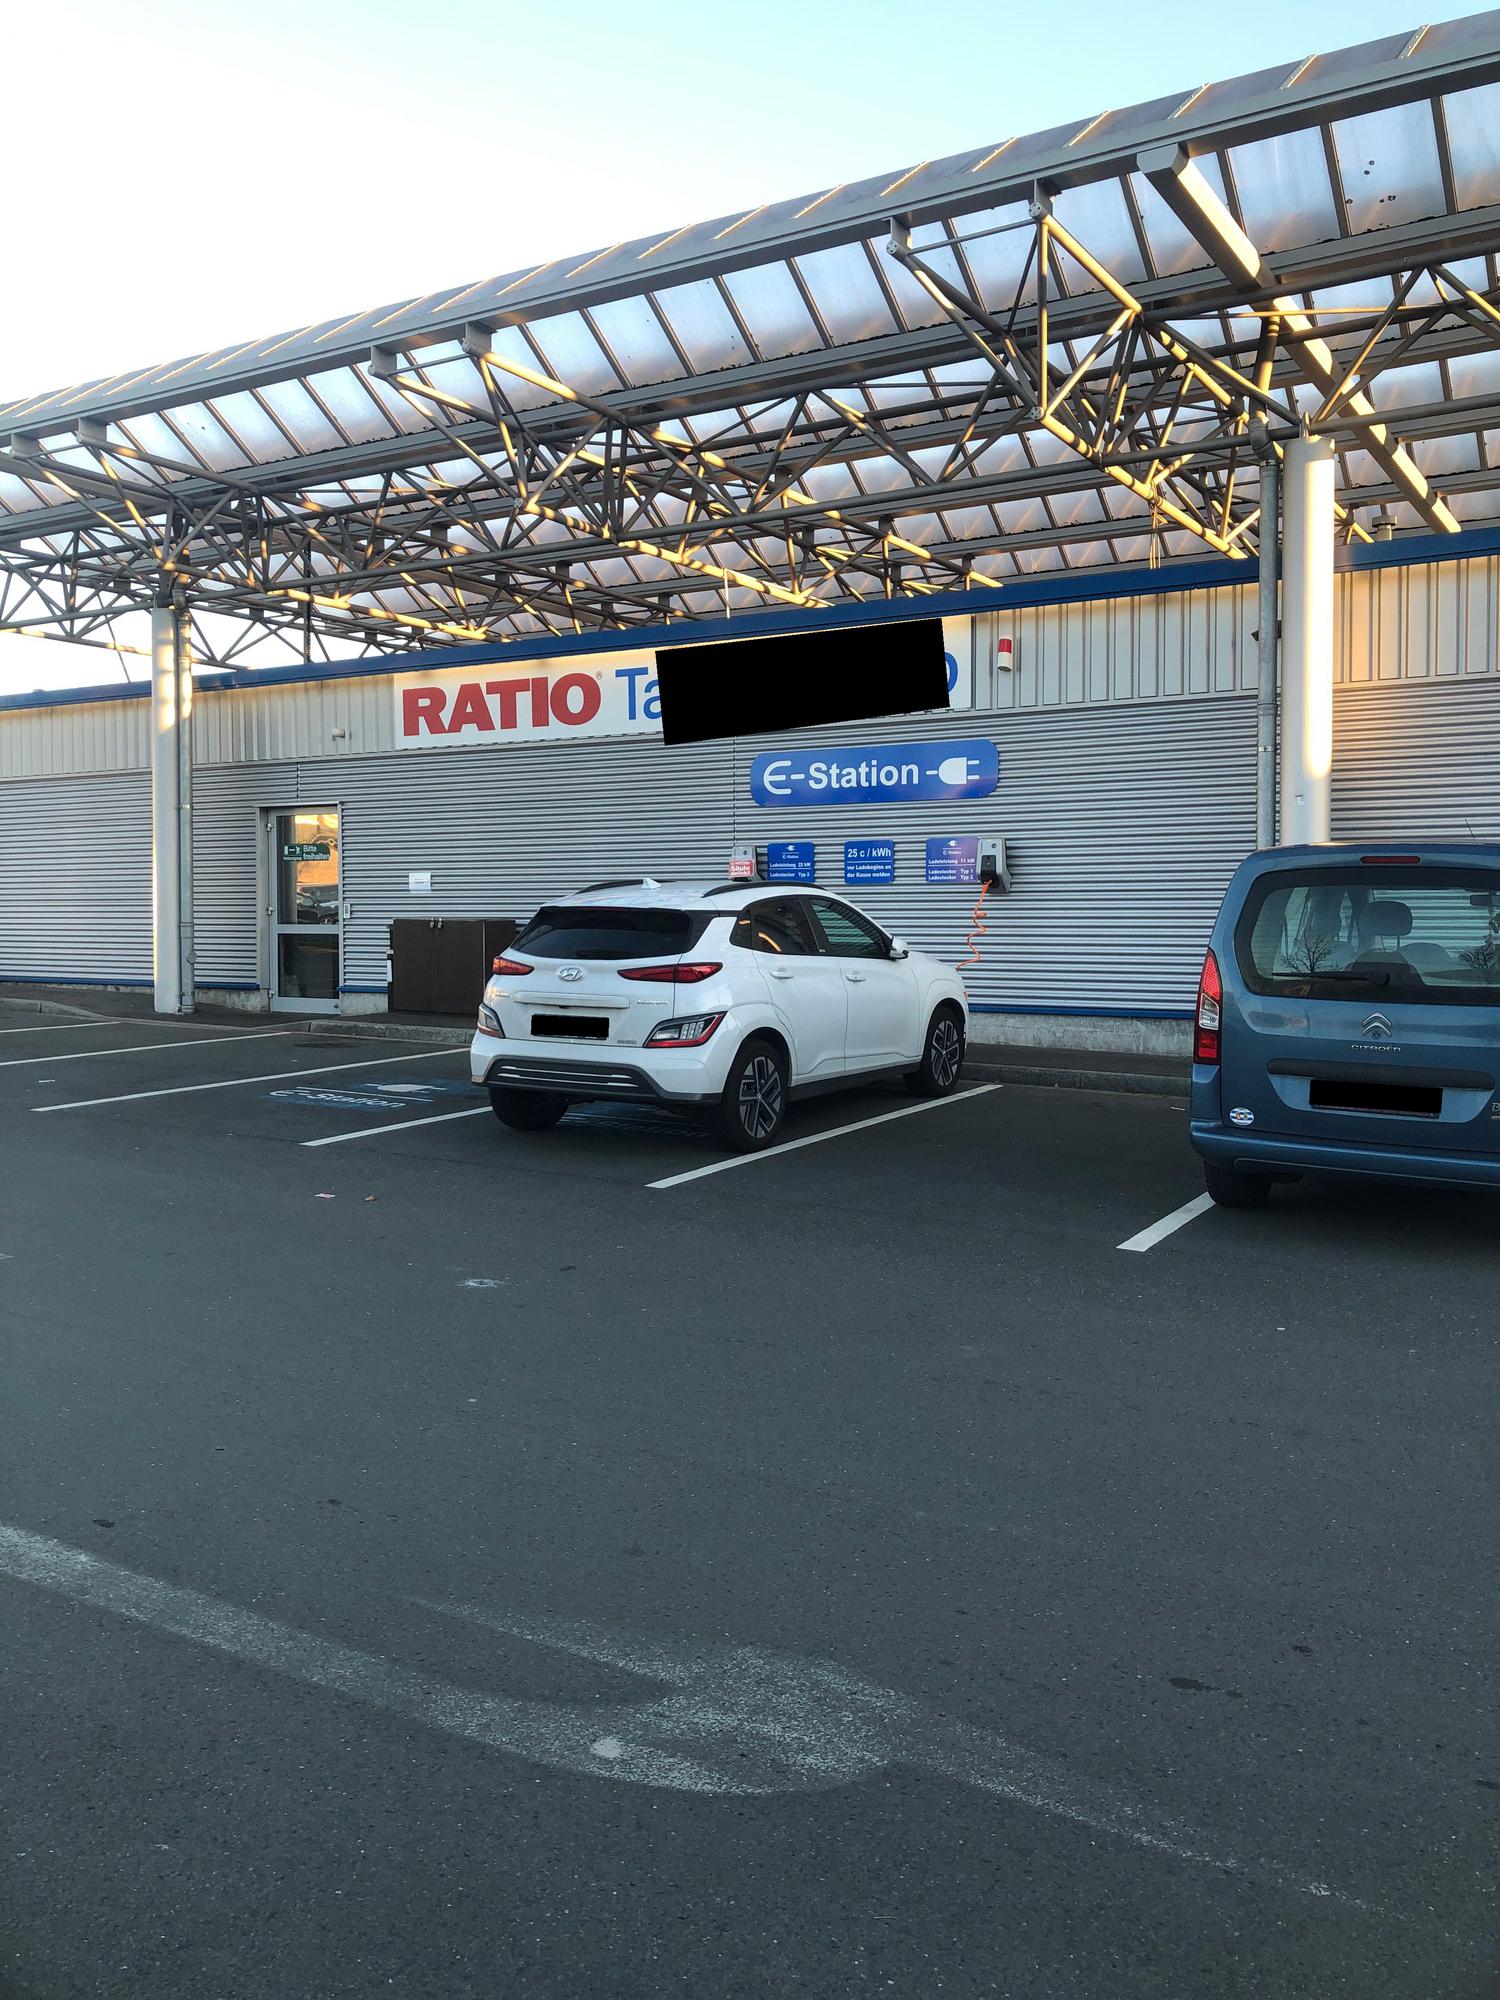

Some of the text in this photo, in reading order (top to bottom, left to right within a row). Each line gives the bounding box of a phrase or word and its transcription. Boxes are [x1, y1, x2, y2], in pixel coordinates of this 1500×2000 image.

[402, 672, 602, 737] RATIO
[847, 848, 858, 858] 25
[872, 847, 892, 857] kWh
